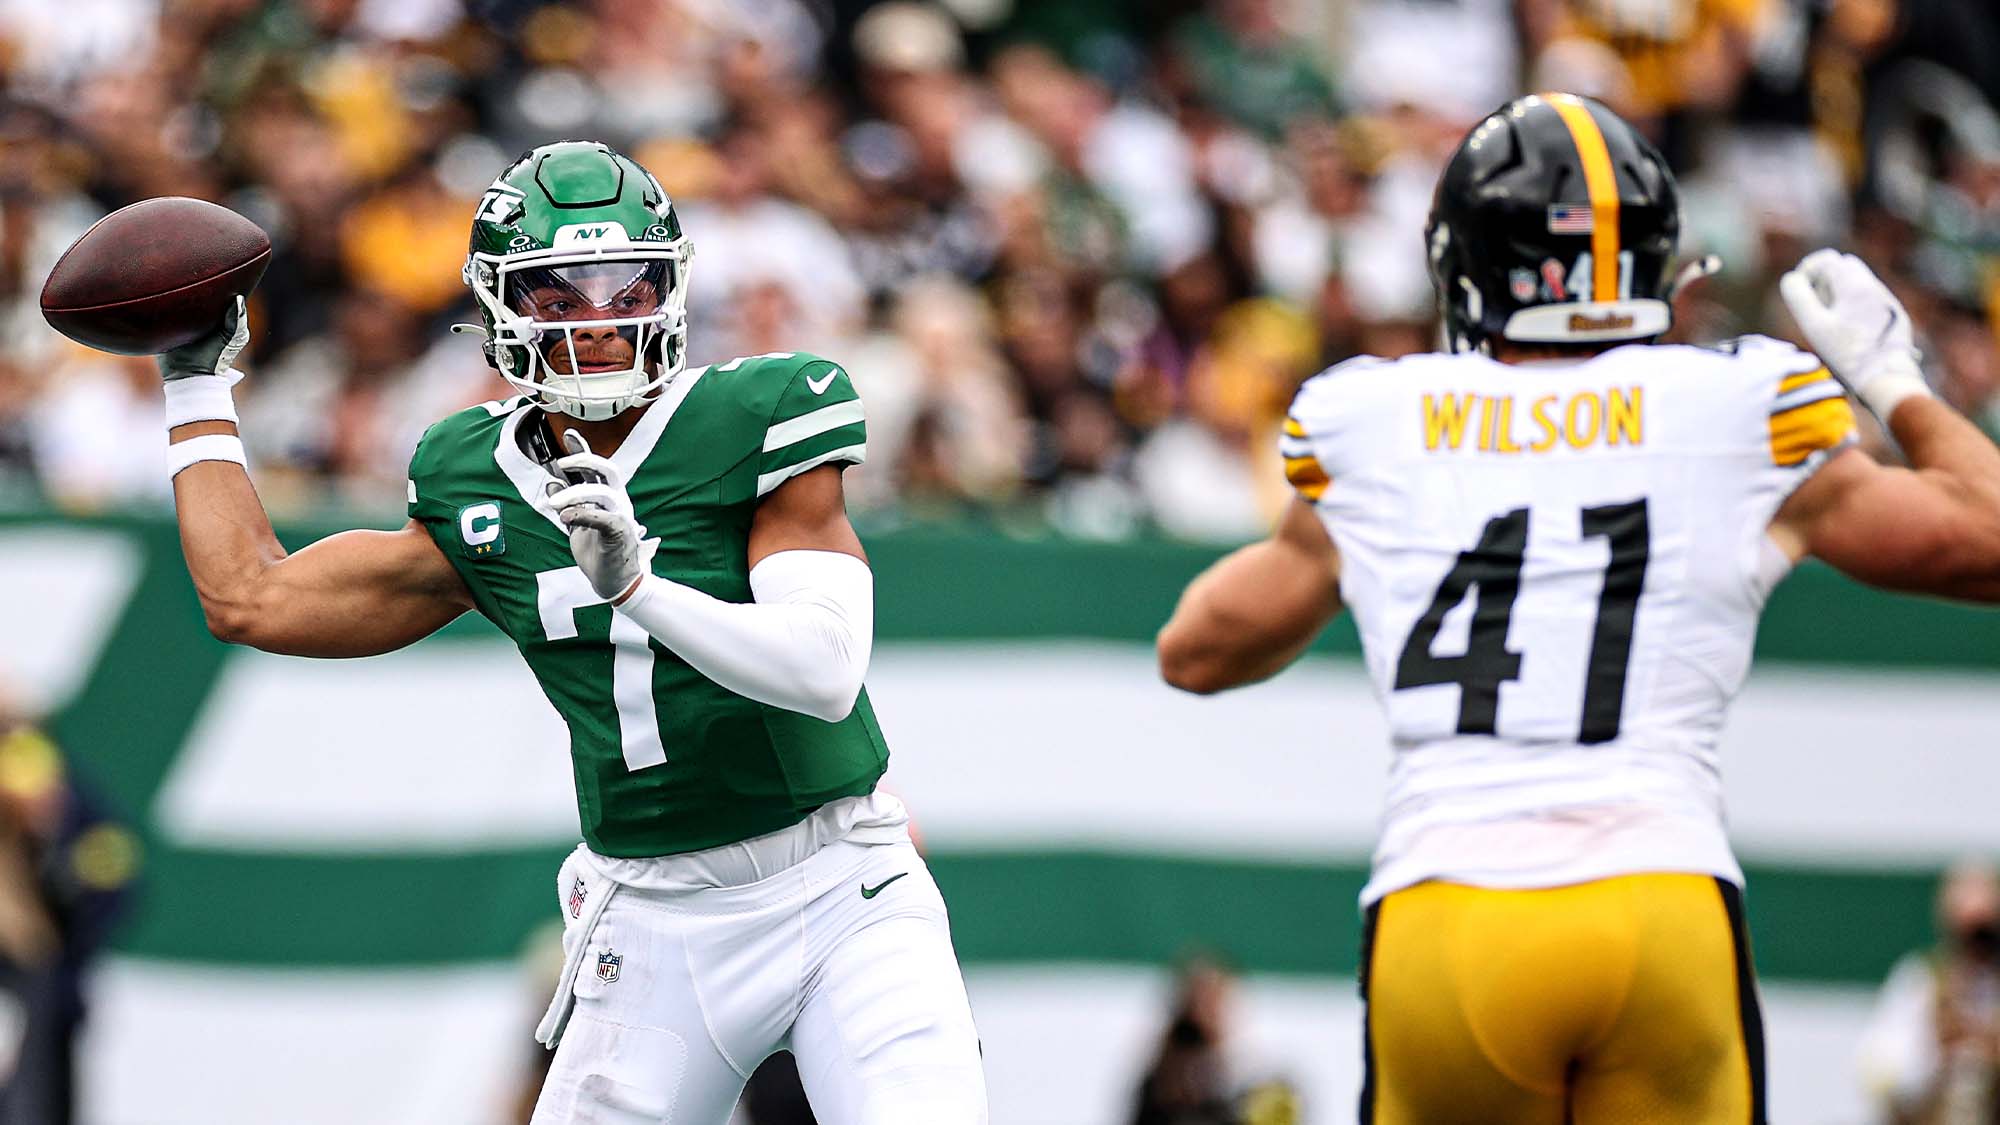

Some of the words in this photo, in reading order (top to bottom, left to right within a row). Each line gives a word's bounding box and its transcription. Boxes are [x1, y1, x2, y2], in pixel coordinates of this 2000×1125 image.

[574, 227, 609, 240] NY
[1566, 251, 1634, 304] 41
[1421, 386, 1645, 453] WILSON
[461, 504, 500, 546] C
[1393, 497, 1650, 745] 41
[535, 537, 667, 772] 7
[598, 964, 616, 978] NFL
